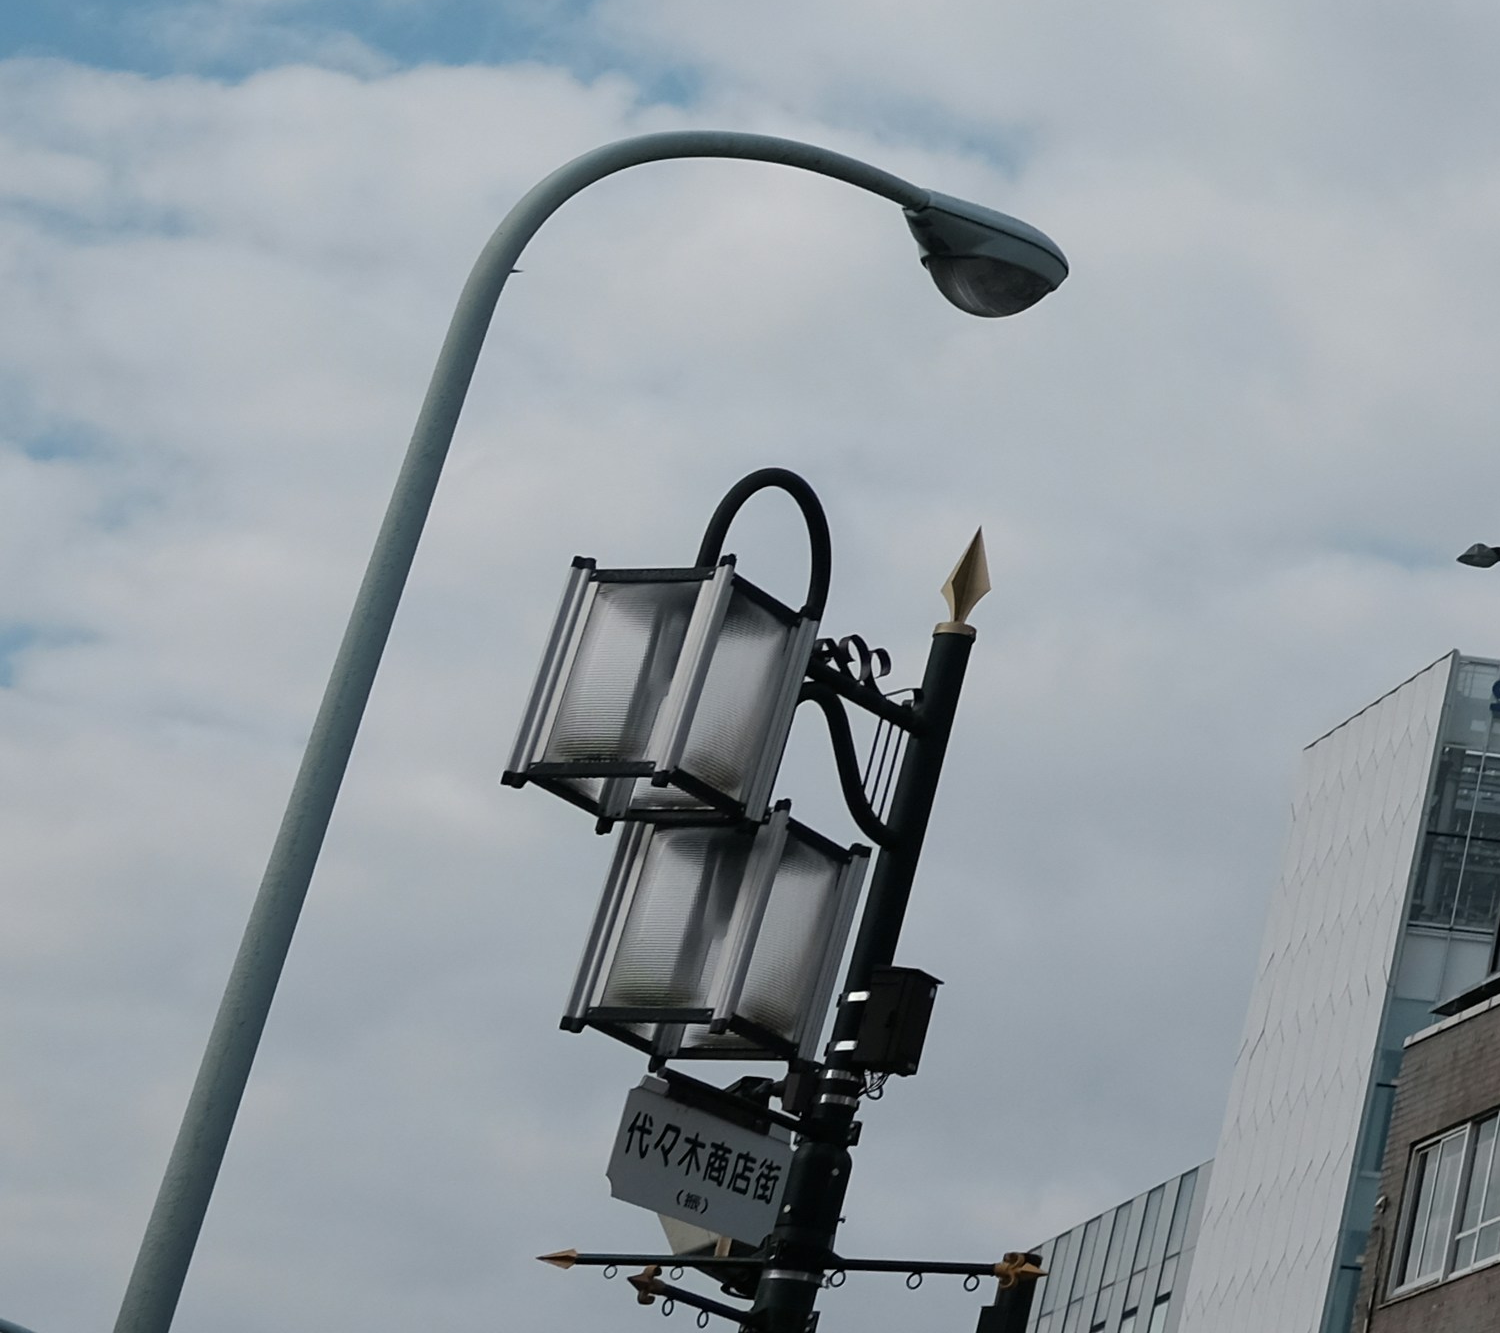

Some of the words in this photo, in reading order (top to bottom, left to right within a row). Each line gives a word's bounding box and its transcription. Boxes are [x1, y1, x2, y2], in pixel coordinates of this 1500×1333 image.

[625, 1110, 782, 1205] 代々木商店街
